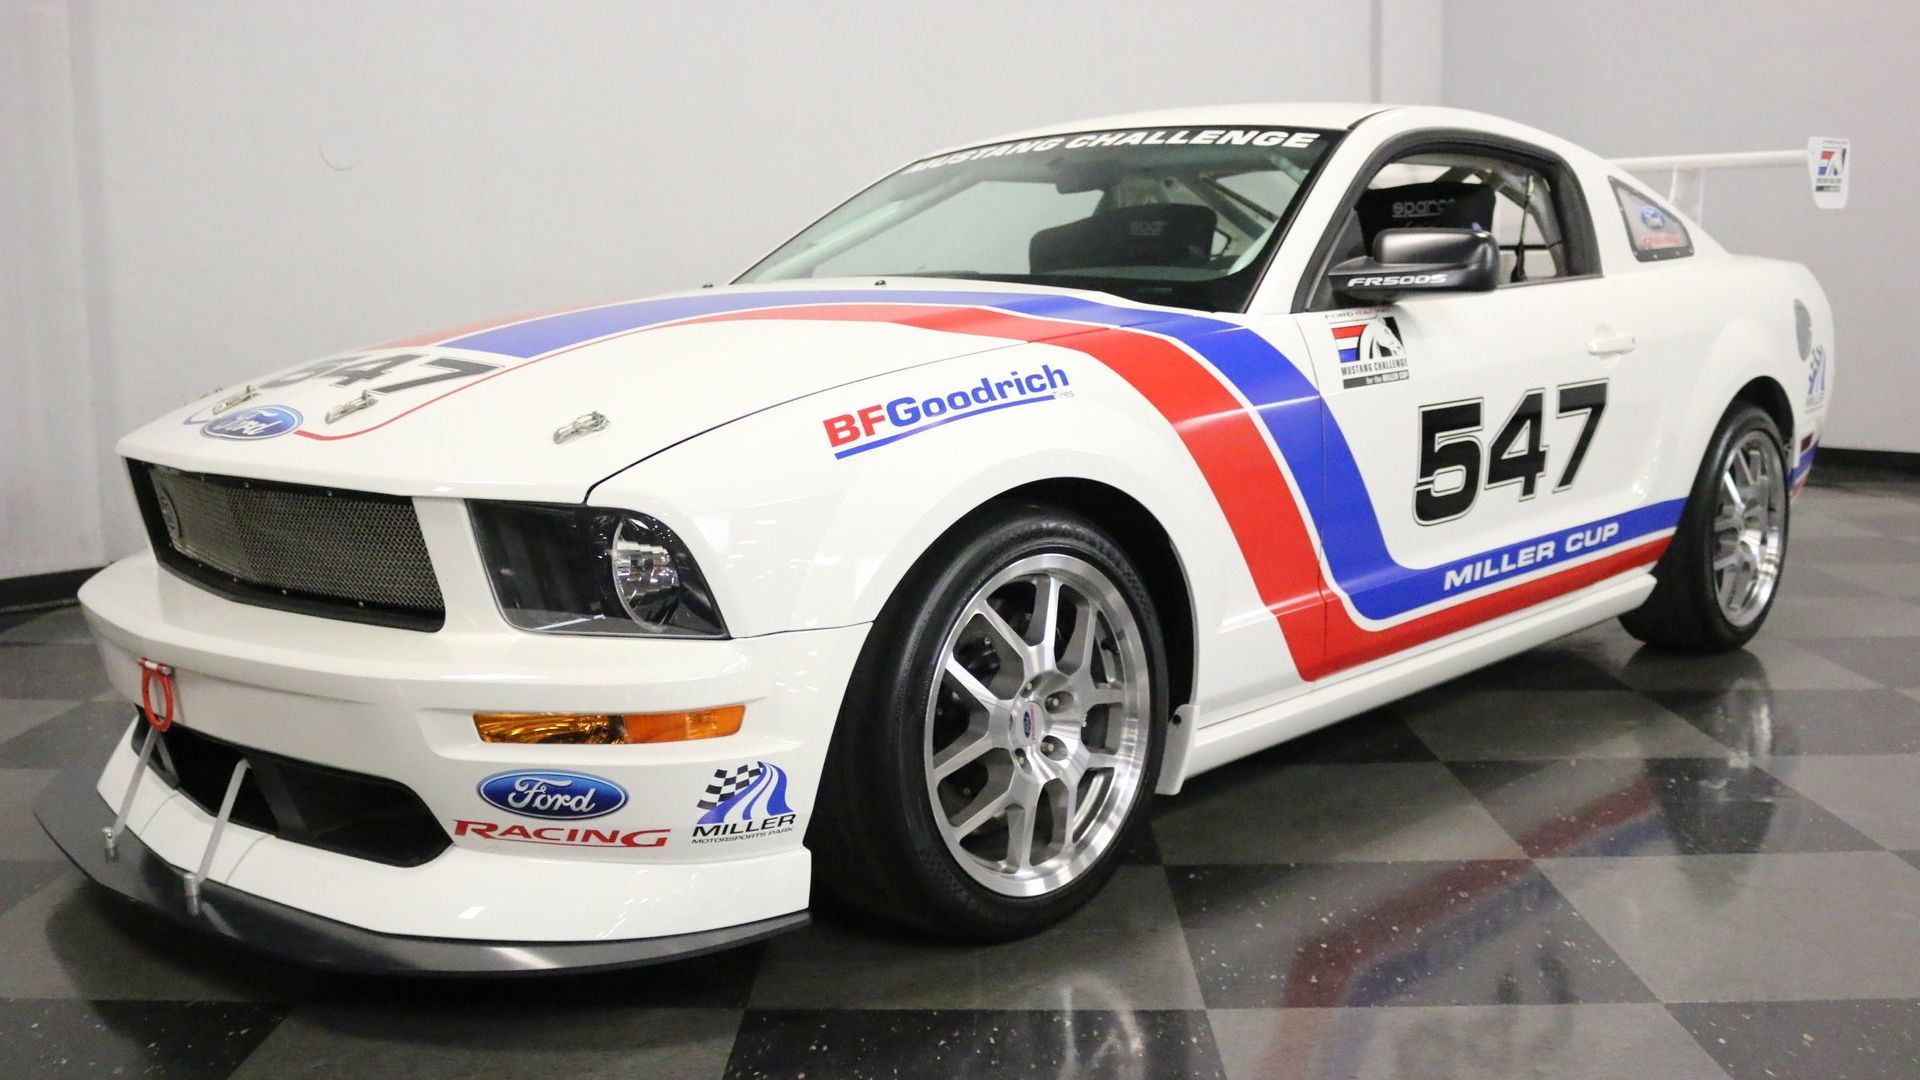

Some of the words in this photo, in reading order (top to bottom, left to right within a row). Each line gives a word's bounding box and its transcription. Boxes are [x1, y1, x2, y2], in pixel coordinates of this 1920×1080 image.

[1065, 129, 1321, 150] CHALLENGE
[1347, 274, 1448, 287] FR500S
[1341, 364, 1373, 376] MUSTANG
[1373, 358, 1408, 372] CHALLENGE
[823, 364, 1070, 448] BFGoodrich
[1411, 377, 1610, 527] 547
[1443, 540, 1556, 591] MILLER
[1565, 521, 1620, 554] CUP
[506, 775, 597, 814] Ford
[453, 818, 672, 848] RACING
[691, 831, 767, 845] MOTORSPORTS
[767, 826, 793, 836] PARK
[692, 813, 797, 837] MILLER
